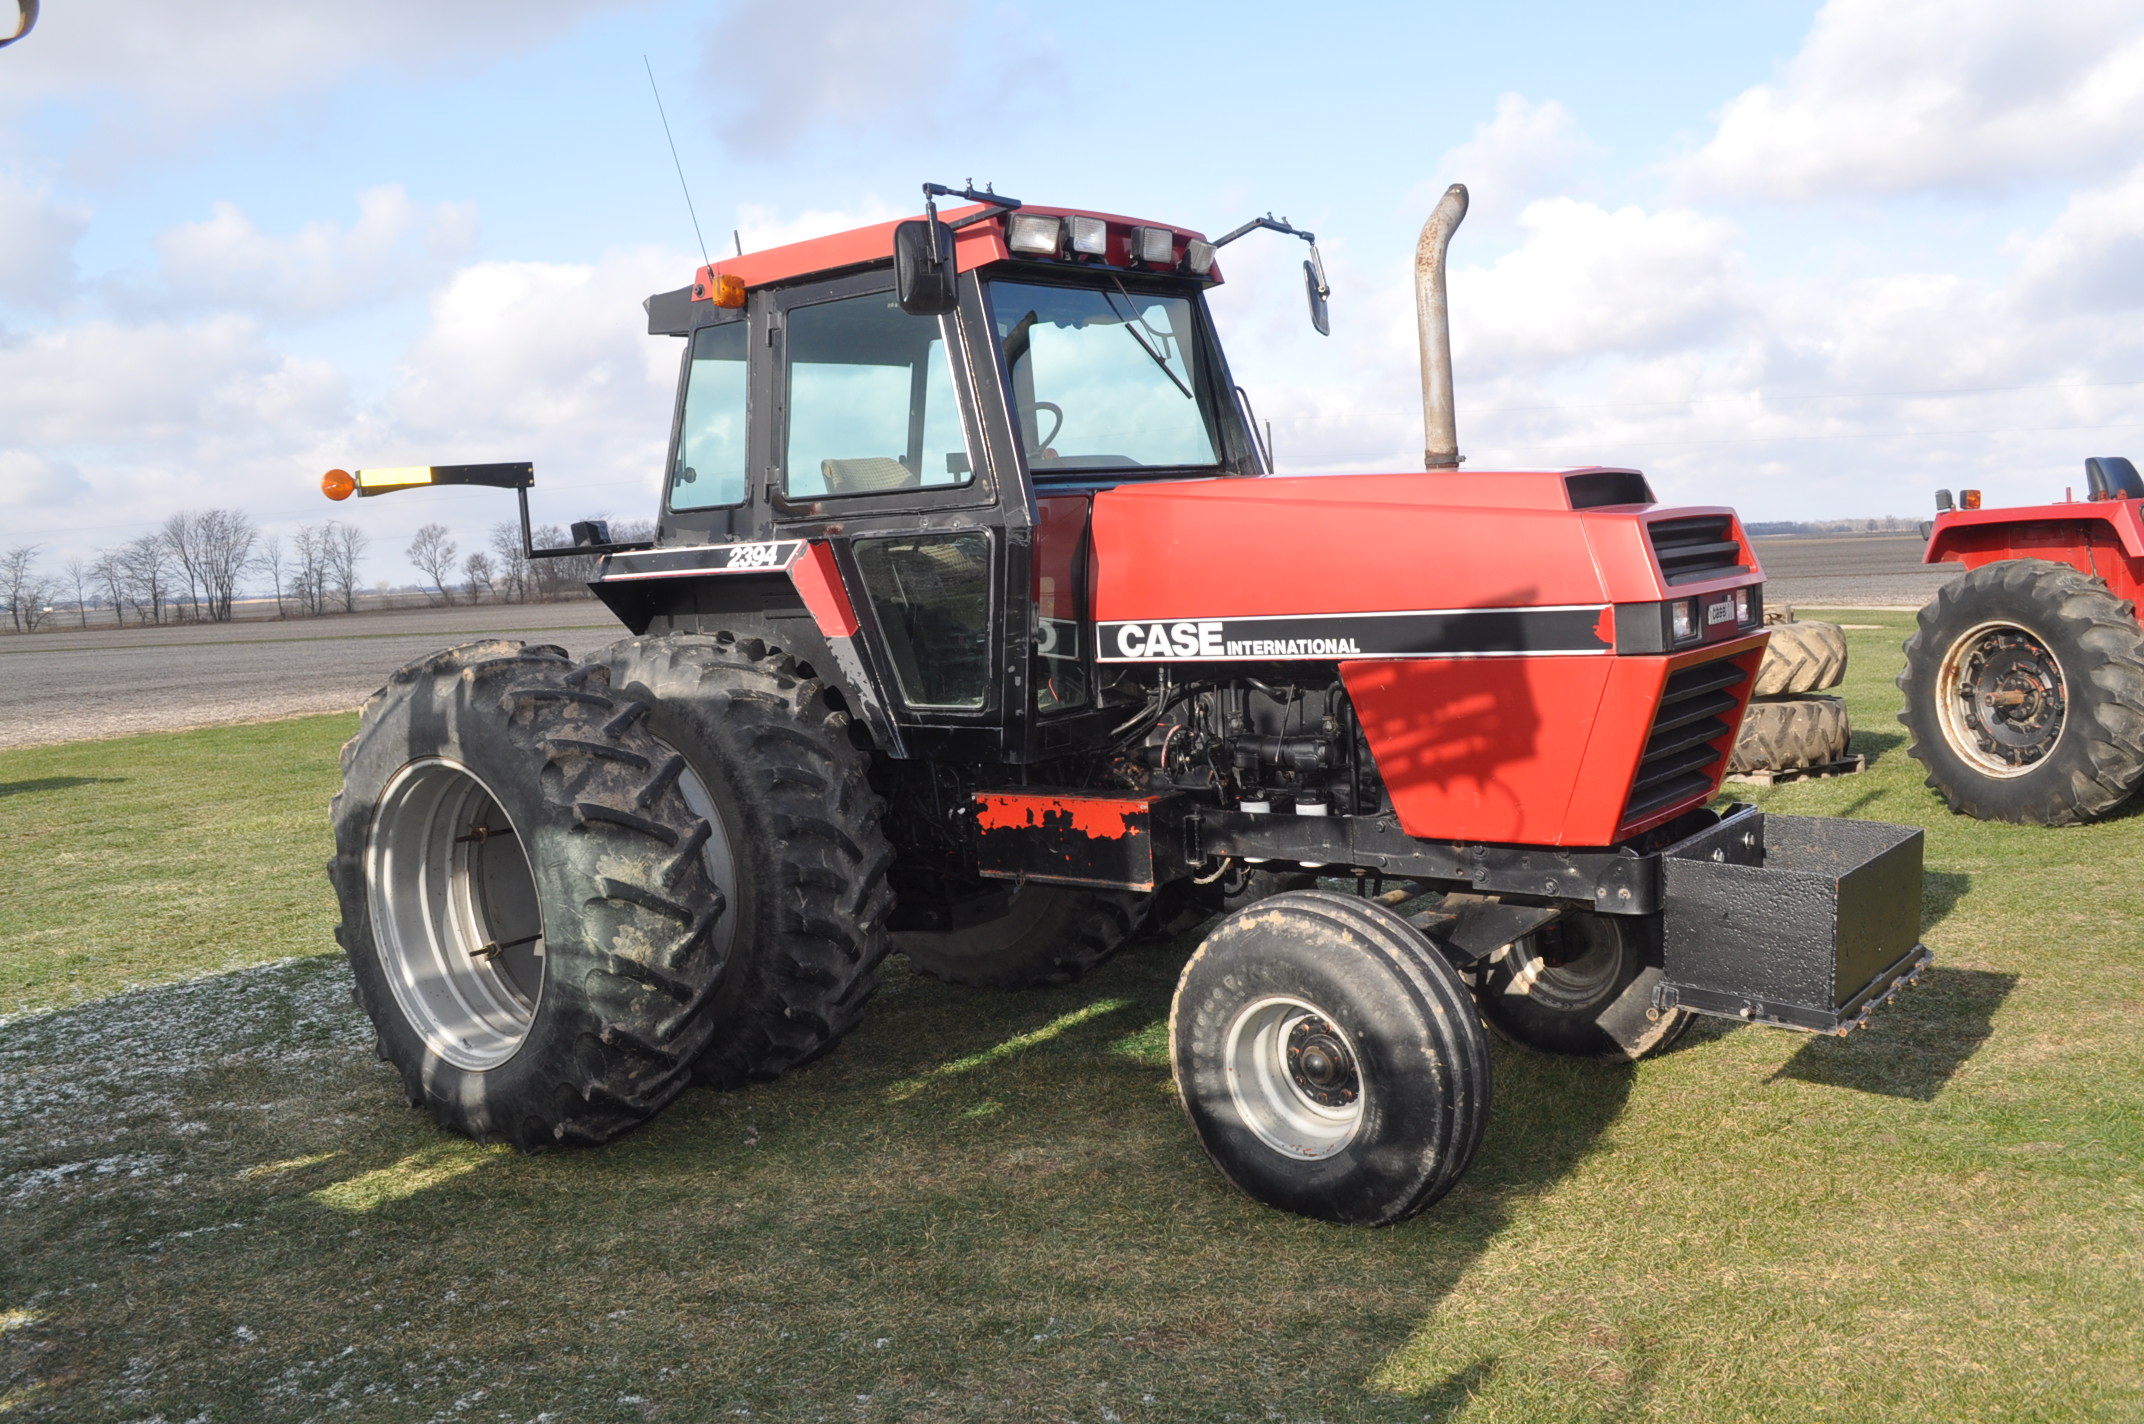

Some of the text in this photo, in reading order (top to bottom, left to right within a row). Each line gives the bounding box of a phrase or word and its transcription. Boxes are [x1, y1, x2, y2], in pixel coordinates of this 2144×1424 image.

[728, 545, 778, 567] 2394
[1117, 622, 1360, 657] CASE INTERNATIONAL
